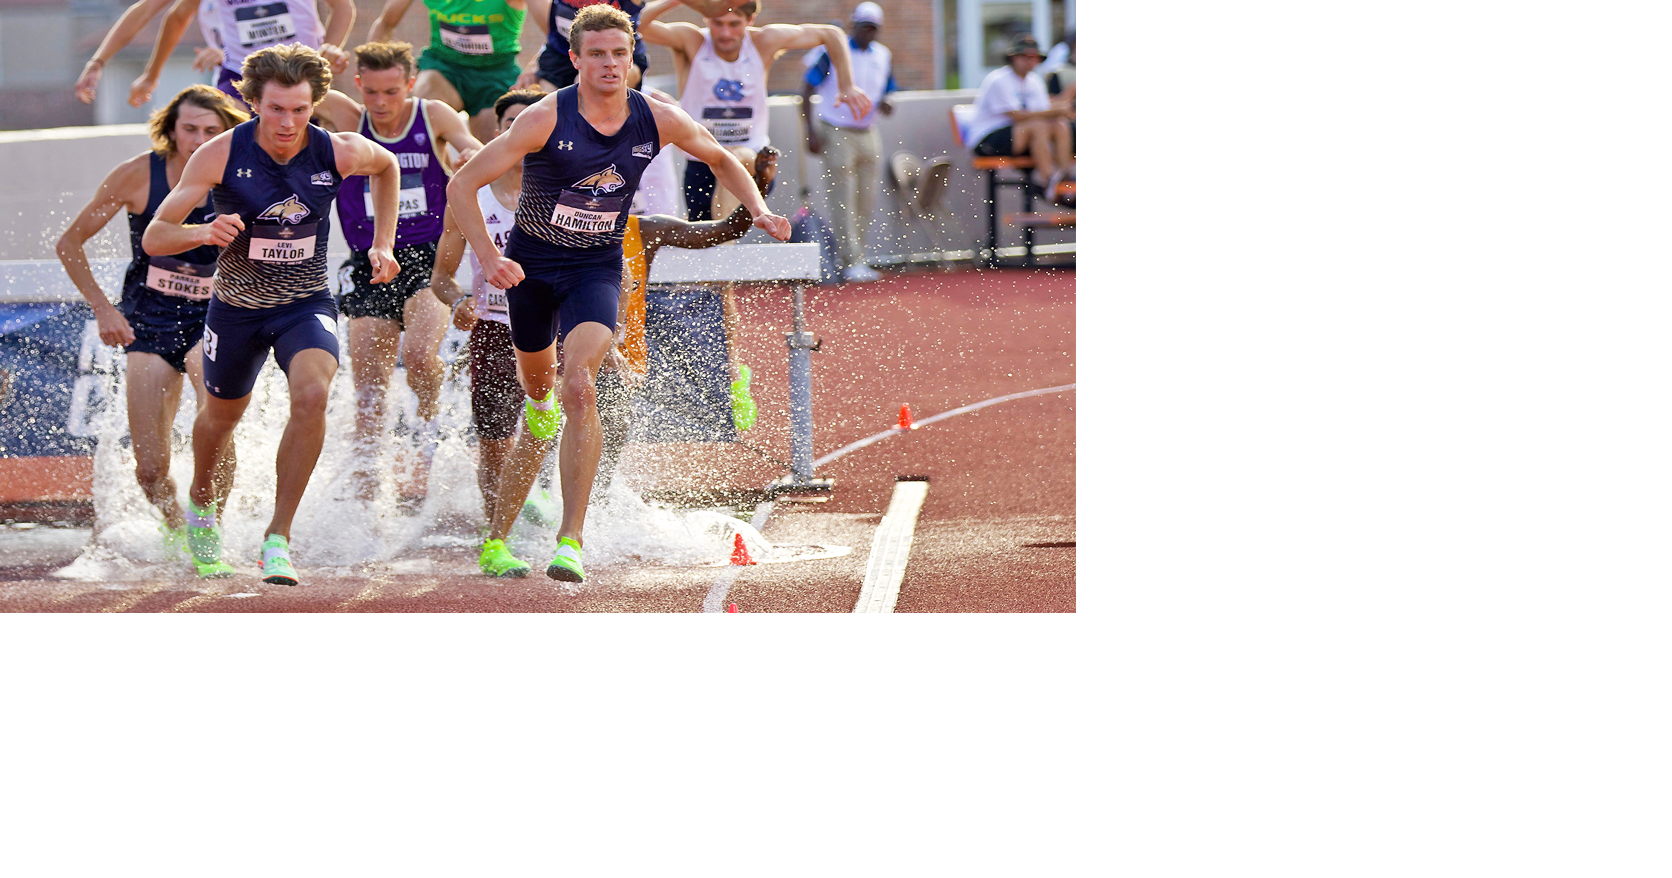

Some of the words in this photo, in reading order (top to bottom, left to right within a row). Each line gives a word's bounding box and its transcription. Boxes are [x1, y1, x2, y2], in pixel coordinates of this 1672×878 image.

[555, 213, 613, 231] HAMILTON
[574, 211, 602, 220] DUNCAN
[262, 248, 305, 259] TAYLOR
[158, 278, 210, 295] STOKES
